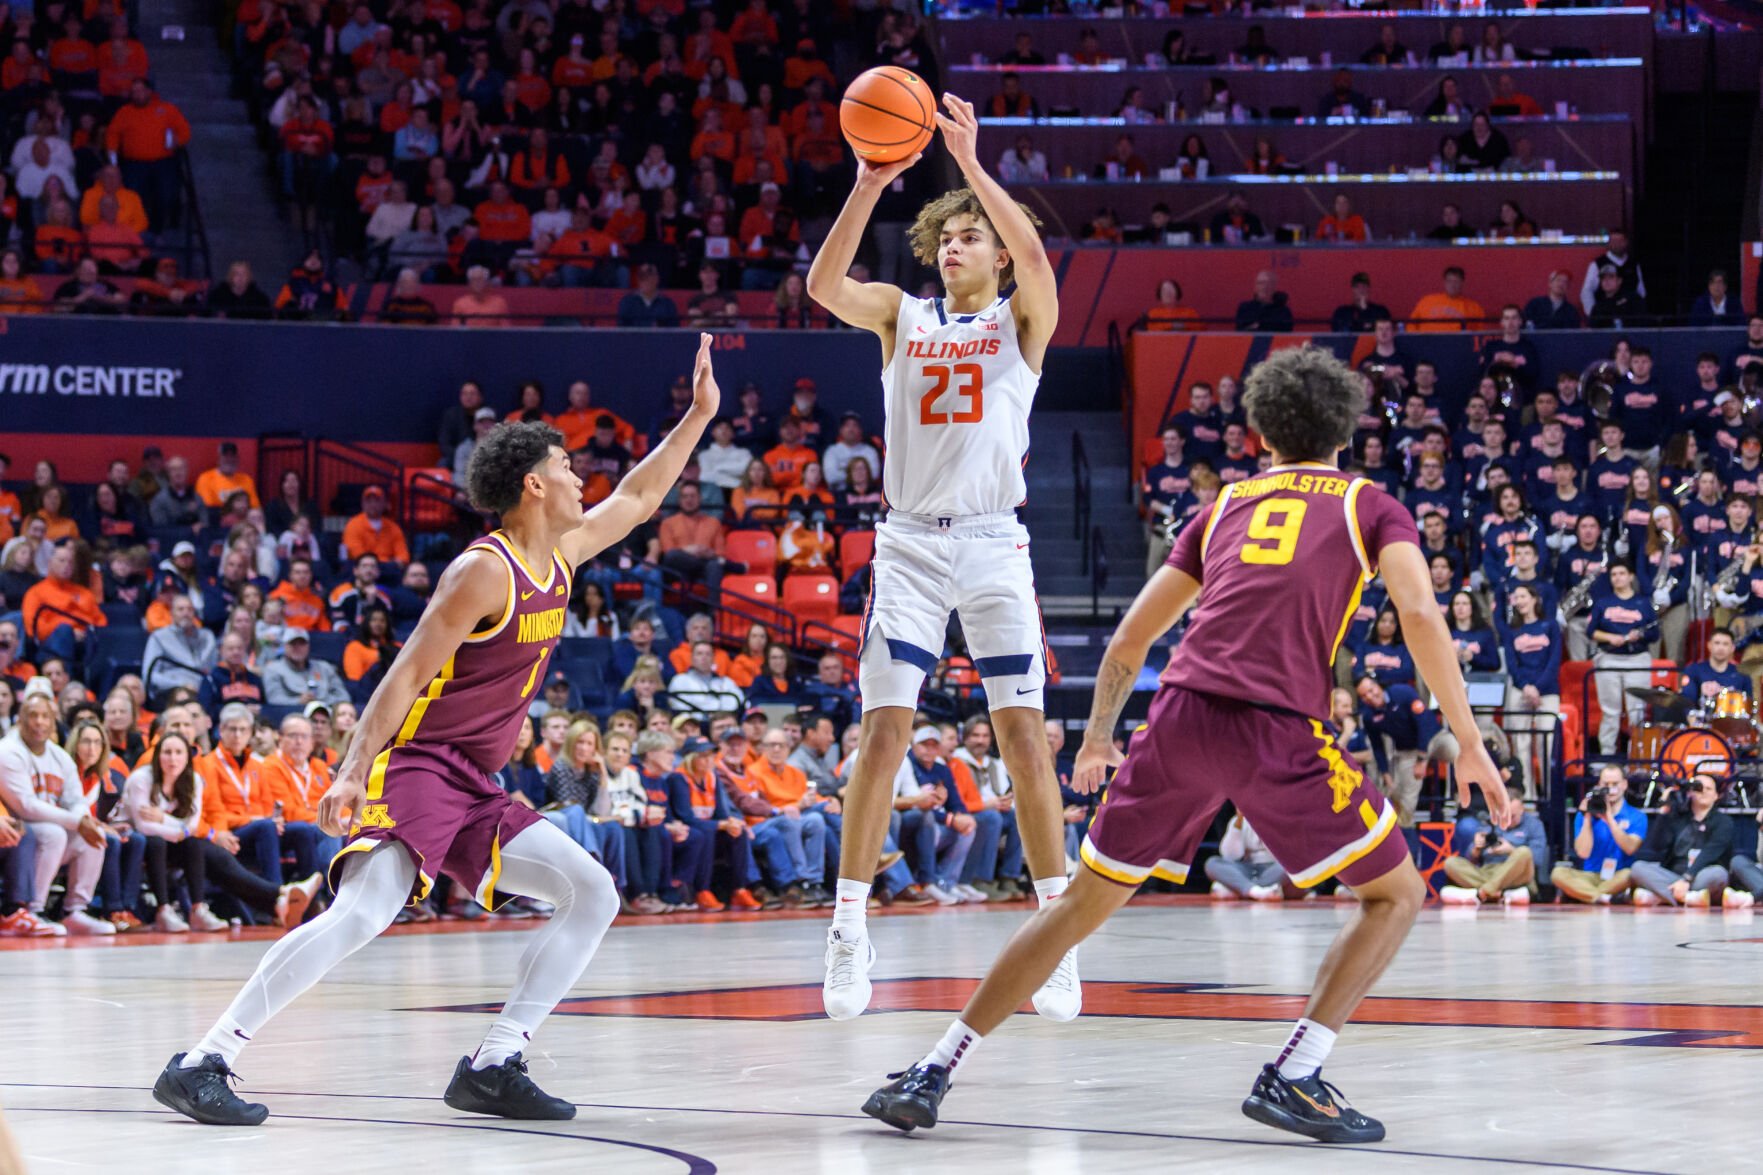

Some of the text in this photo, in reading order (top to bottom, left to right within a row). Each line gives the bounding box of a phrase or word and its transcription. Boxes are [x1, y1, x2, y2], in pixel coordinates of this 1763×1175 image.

[906, 338, 1001, 359] ILLINOIS
[53, 365, 175, 397] CENTER
[920, 363, 984, 426] 23
[1231, 472, 1349, 499] SHINHOLSTER
[1240, 497, 1308, 566] 9
[520, 647, 549, 698] 1
